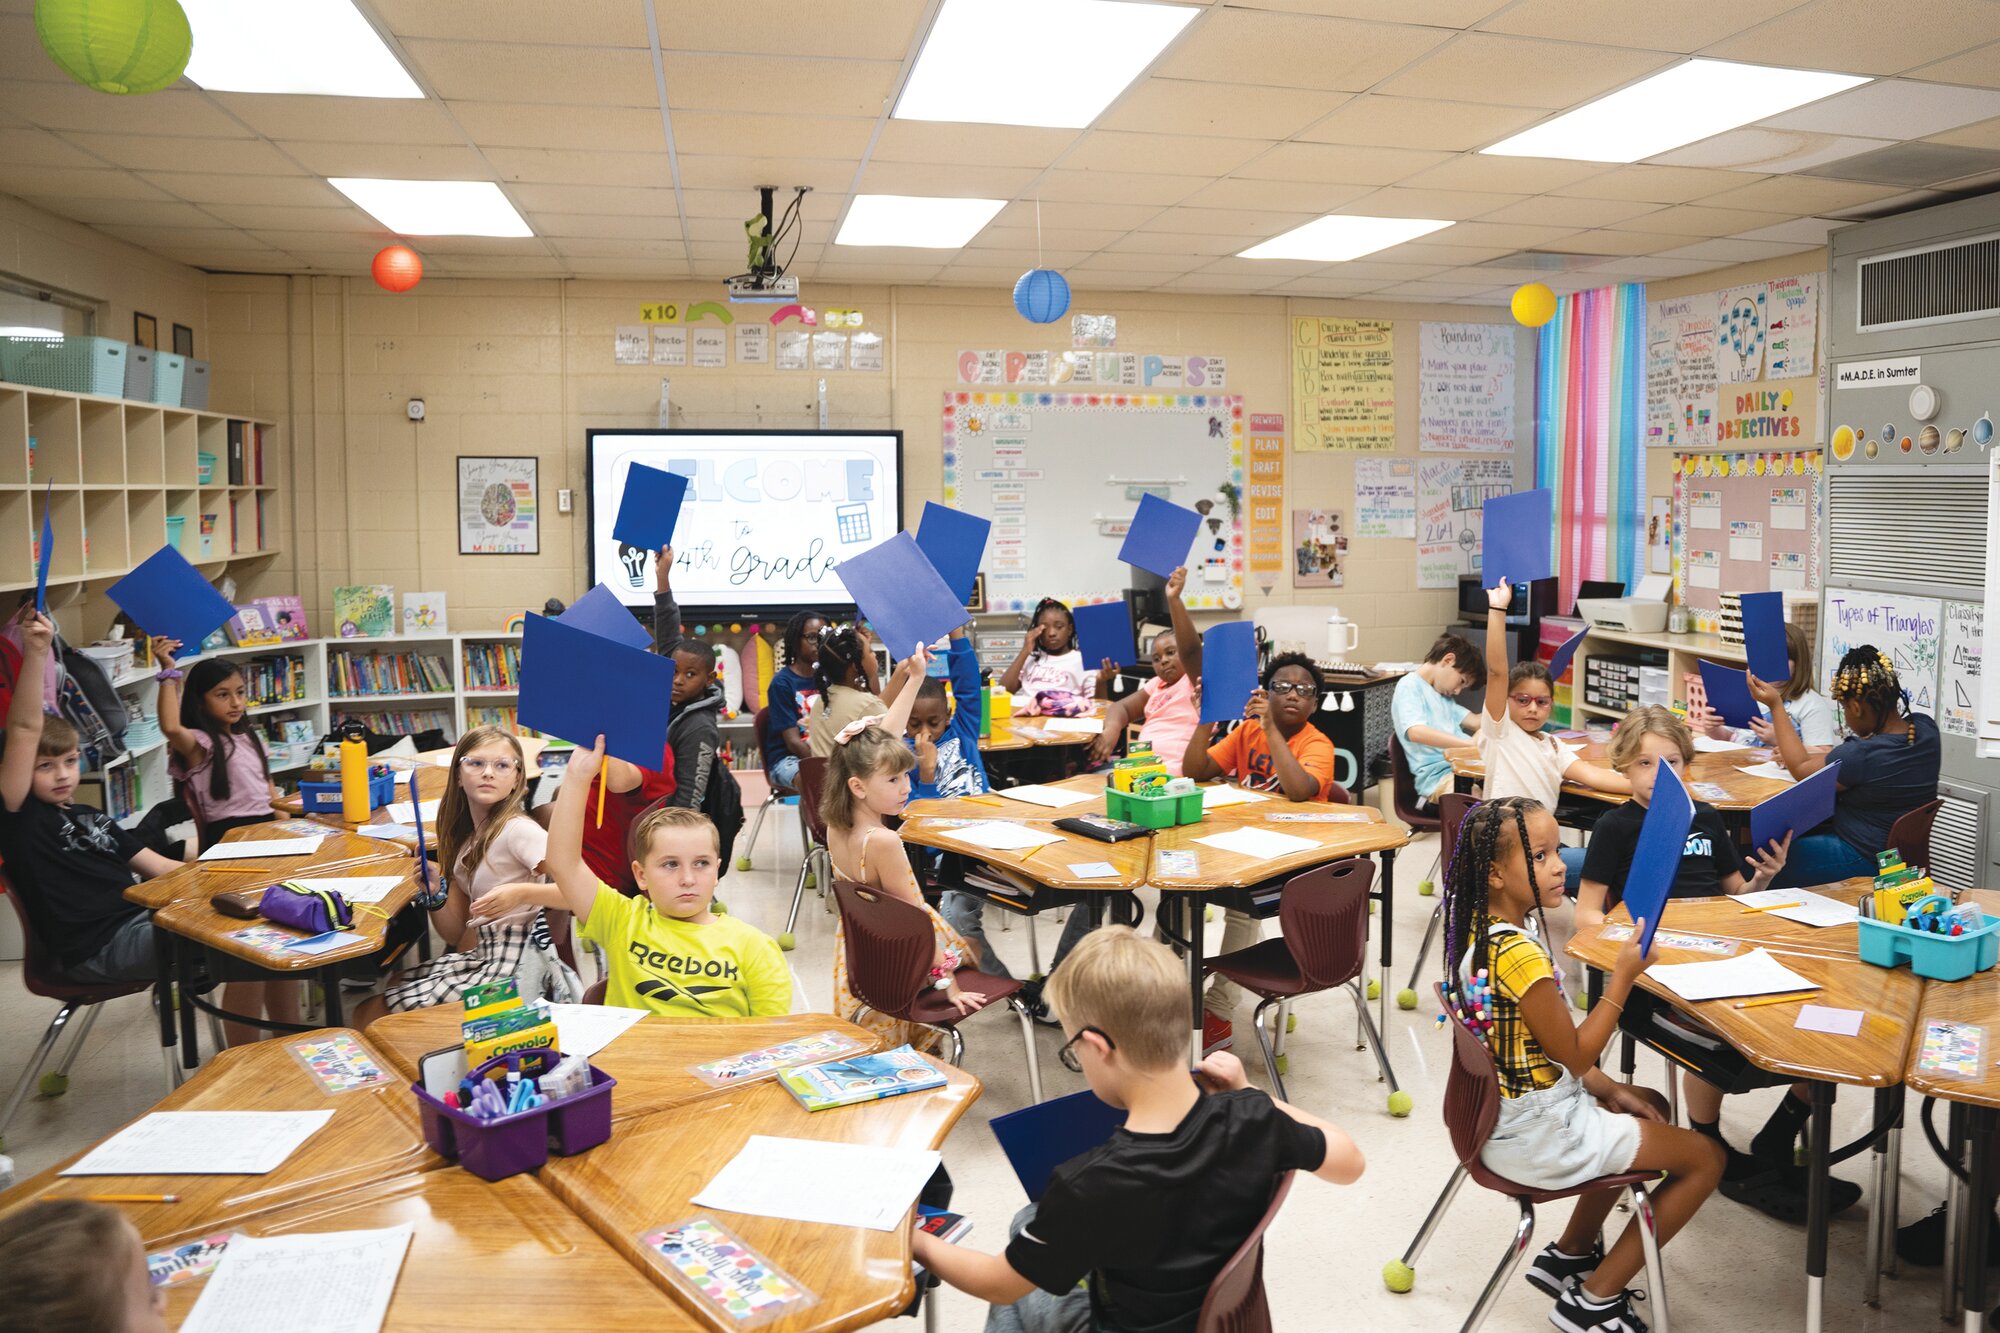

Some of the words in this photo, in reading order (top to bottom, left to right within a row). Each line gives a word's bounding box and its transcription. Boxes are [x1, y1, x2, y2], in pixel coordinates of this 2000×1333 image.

[657, 305, 677, 320] 10
[742, 327, 761, 335] unit
[696, 337, 722, 346] deca-
[1440, 327, 1483, 350] Rounding
[1451, 363, 1467, 374] your
[1731, 367, 1756, 382] LIGHT
[1877, 369, 1885, 379] in
[1886, 366, 1918, 378] Sumter
[1736, 391, 1779, 415] DAILY
[1251, 415, 1284, 425] PREWRITE
[1717, 416, 1800, 442] OBJECTIVES
[1255, 438, 1279, 450] PLAN
[1253, 461, 1280, 473] DRAFT
[622, 458, 875, 501] ELCOME
[1251, 485, 1282, 497] REVISE
[1255, 507, 1276, 520] EDIT
[730, 519, 753, 537] to
[473, 544, 526, 552] MINDSET
[676, 539, 720, 572] 4th
[361, 605, 380, 613] LOVE
[360, 613, 385, 622] MATH
[1832, 599, 1864, 631] Types
[1867, 607, 1879, 624] of
[1880, 606, 1935, 642] Triangles
[1960, 622, 1969, 639] by
[629, 941, 738, 981] Reebok
[467, 994, 481, 1008] 12
[493, 1035, 549, 1057] Crayola
